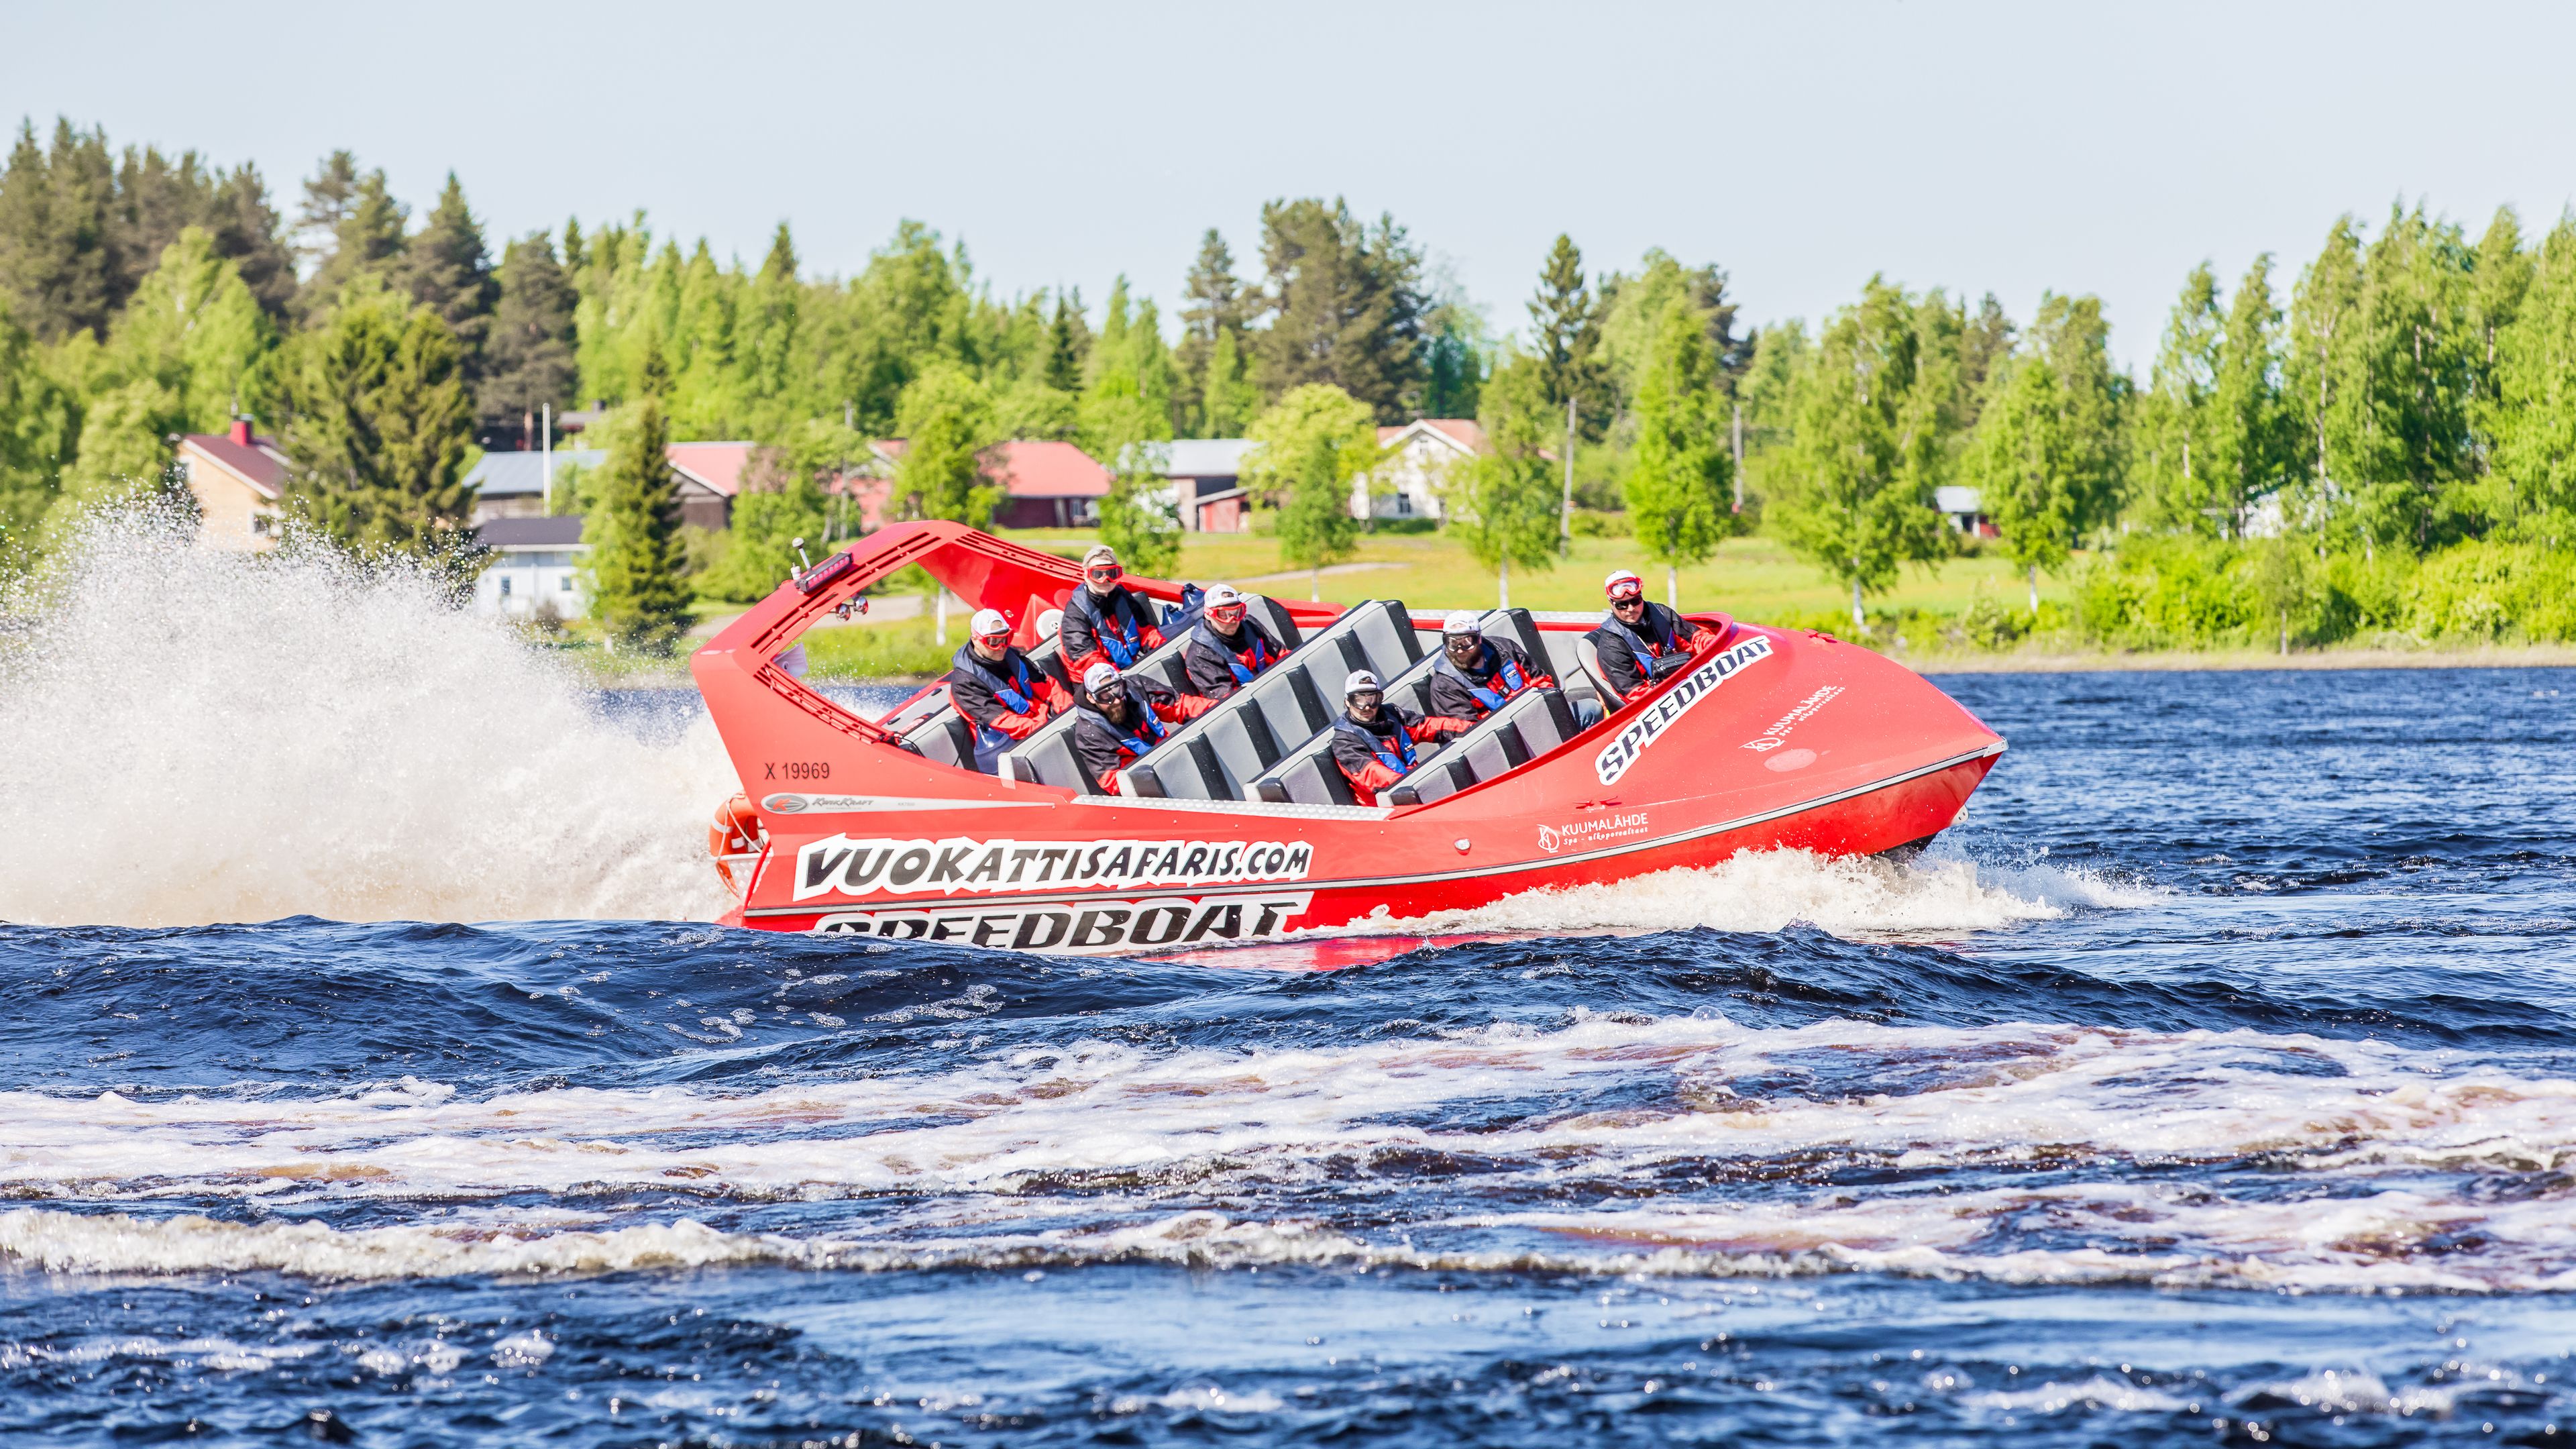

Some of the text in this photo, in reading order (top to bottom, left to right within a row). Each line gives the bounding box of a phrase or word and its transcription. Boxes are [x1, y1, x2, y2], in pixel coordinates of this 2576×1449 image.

[1601, 639, 1770, 781] SPEEDBOAT
[1763, 685, 1837, 735] KUUMALÄHDE
[765, 763, 830, 780] X 19969
[1562, 813, 1648, 836] KUUMALÄHDE
[806, 846, 1309, 888] VUOKATTISAFARIS.COM
